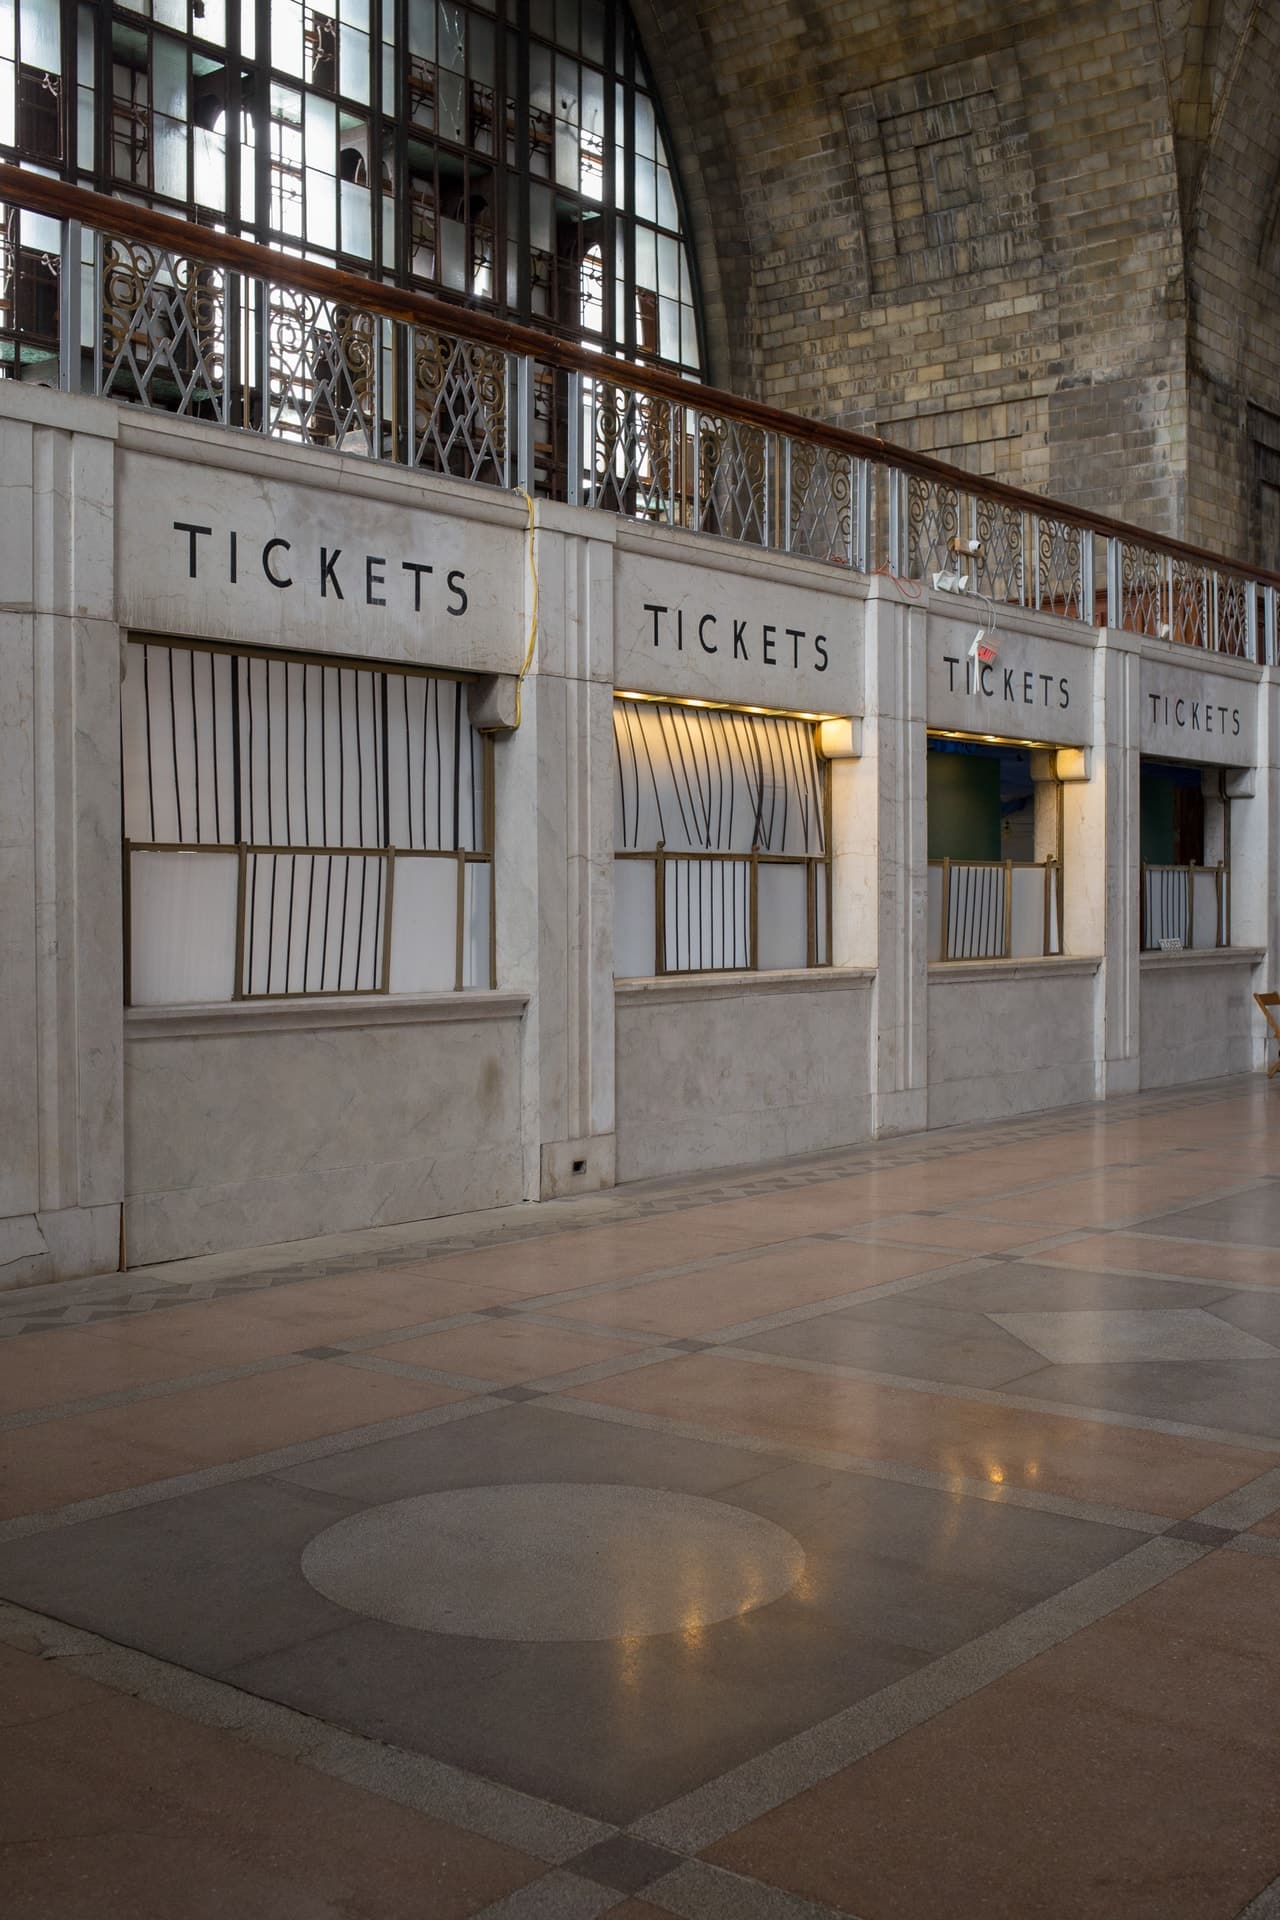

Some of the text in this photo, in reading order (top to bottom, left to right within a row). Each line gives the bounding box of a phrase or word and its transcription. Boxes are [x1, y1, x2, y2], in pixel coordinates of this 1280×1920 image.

[173, 521, 468, 617] TICKETS
[643, 603, 829, 672] TICKETS
[943, 656, 1070, 709] TICKETS
[1148, 693, 1240, 736] TICKETS
